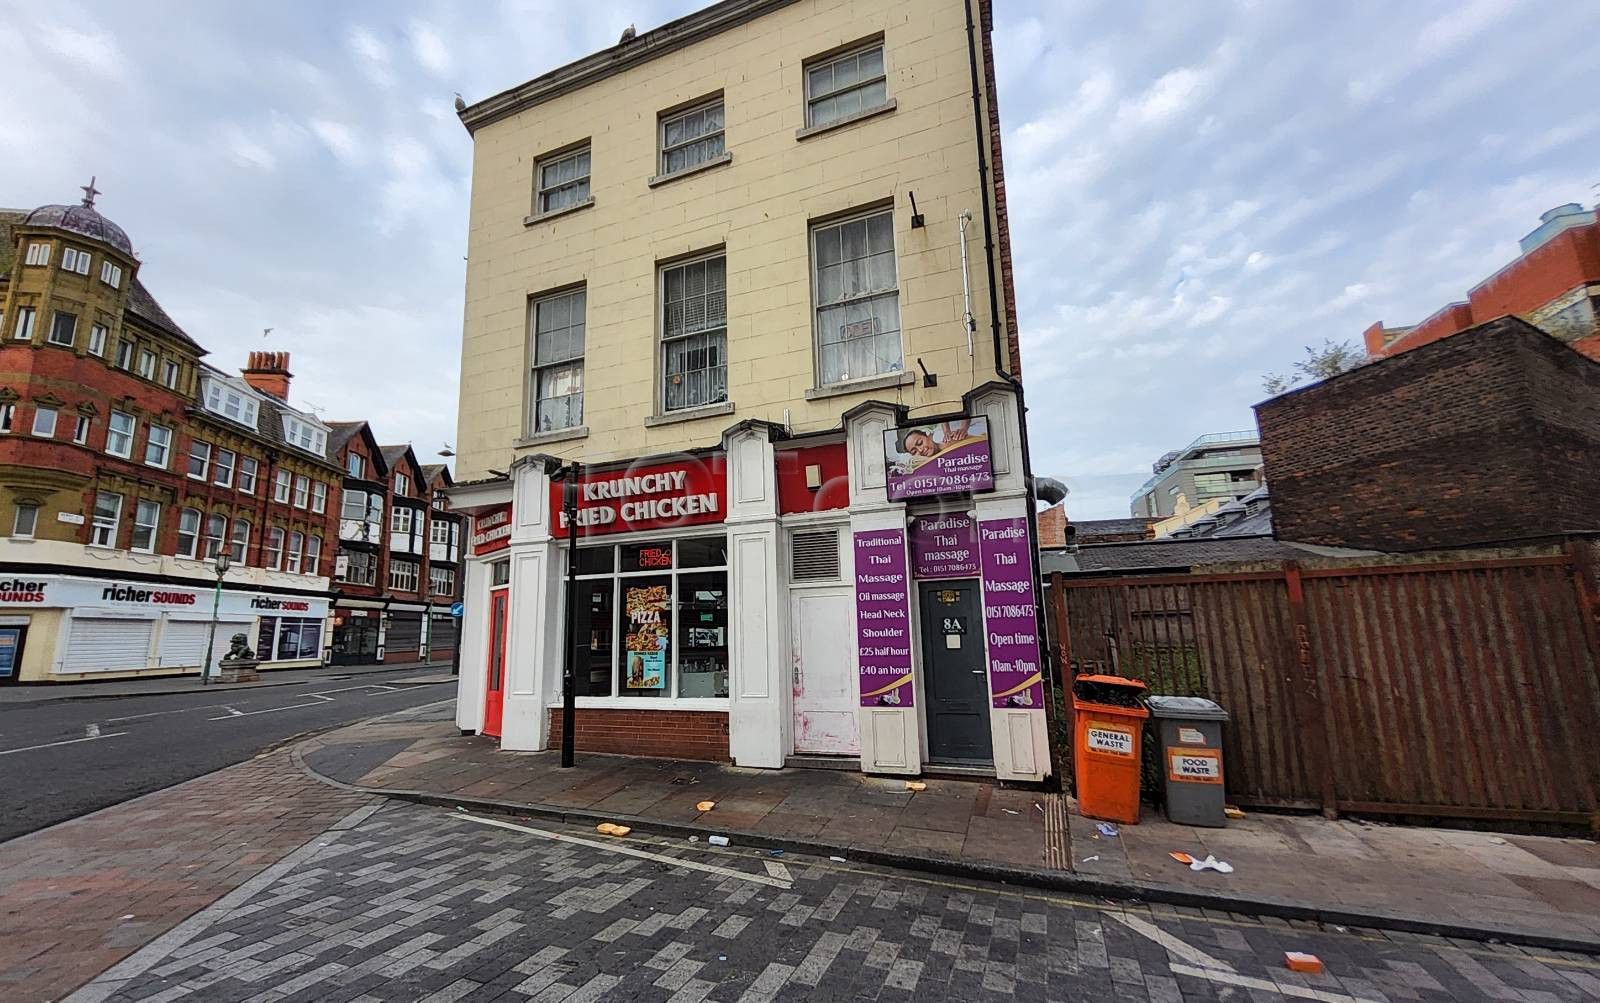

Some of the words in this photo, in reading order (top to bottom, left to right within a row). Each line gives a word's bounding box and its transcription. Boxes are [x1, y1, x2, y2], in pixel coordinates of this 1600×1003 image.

[937, 452, 989, 468] Paradise
[957, 464, 984, 473] massage
[583, 470, 687, 501] KRUNCHY
[890, 481, 907, 492] Tel
[620, 492, 719, 524] CHICKEN
[920, 515, 970, 531] Paradise
[982, 526, 1026, 540] Paradise
[857, 535, 902, 548] Traditional
[934, 534, 958, 547] Thai
[640, 548, 661, 558] FRIED
[924, 549, 970, 562] massage
[994, 553, 1017, 565] Thai
[639, 556, 672, 567] CHICKEN
[869, 555, 892, 565] Thai
[858, 574, 904, 584] Massage
[985, 580, 1031, 594] Massage
[0, 592, 45, 602] UNDS
[102, 584, 153, 604] richer
[859, 592, 871, 601] Oil
[871, 592, 905, 602] massage
[250, 595, 282, 610] richer
[631, 610, 661, 624] PIZZA
[860, 610, 882, 619] Head
[883, 609, 906, 618] Neck
[943, 618, 962, 630] 8A
[862, 628, 904, 638] Shoulder
[990, 633, 1014, 648] Open
[1015, 633, 1035, 645] time
[860, 647, 874, 656] £25
[874, 647, 890, 656] half
[890, 647, 909, 656] hour
[860, 666, 877, 675] £40
[878, 667, 888, 675] an
[890, 665, 910, 675] hour
[1090, 730, 1130, 743] GENERAL
[1096, 738, 1124, 750] WASTE
[1182, 757, 1207, 767] FOOD
[1182, 765, 1210, 775] WASTE
